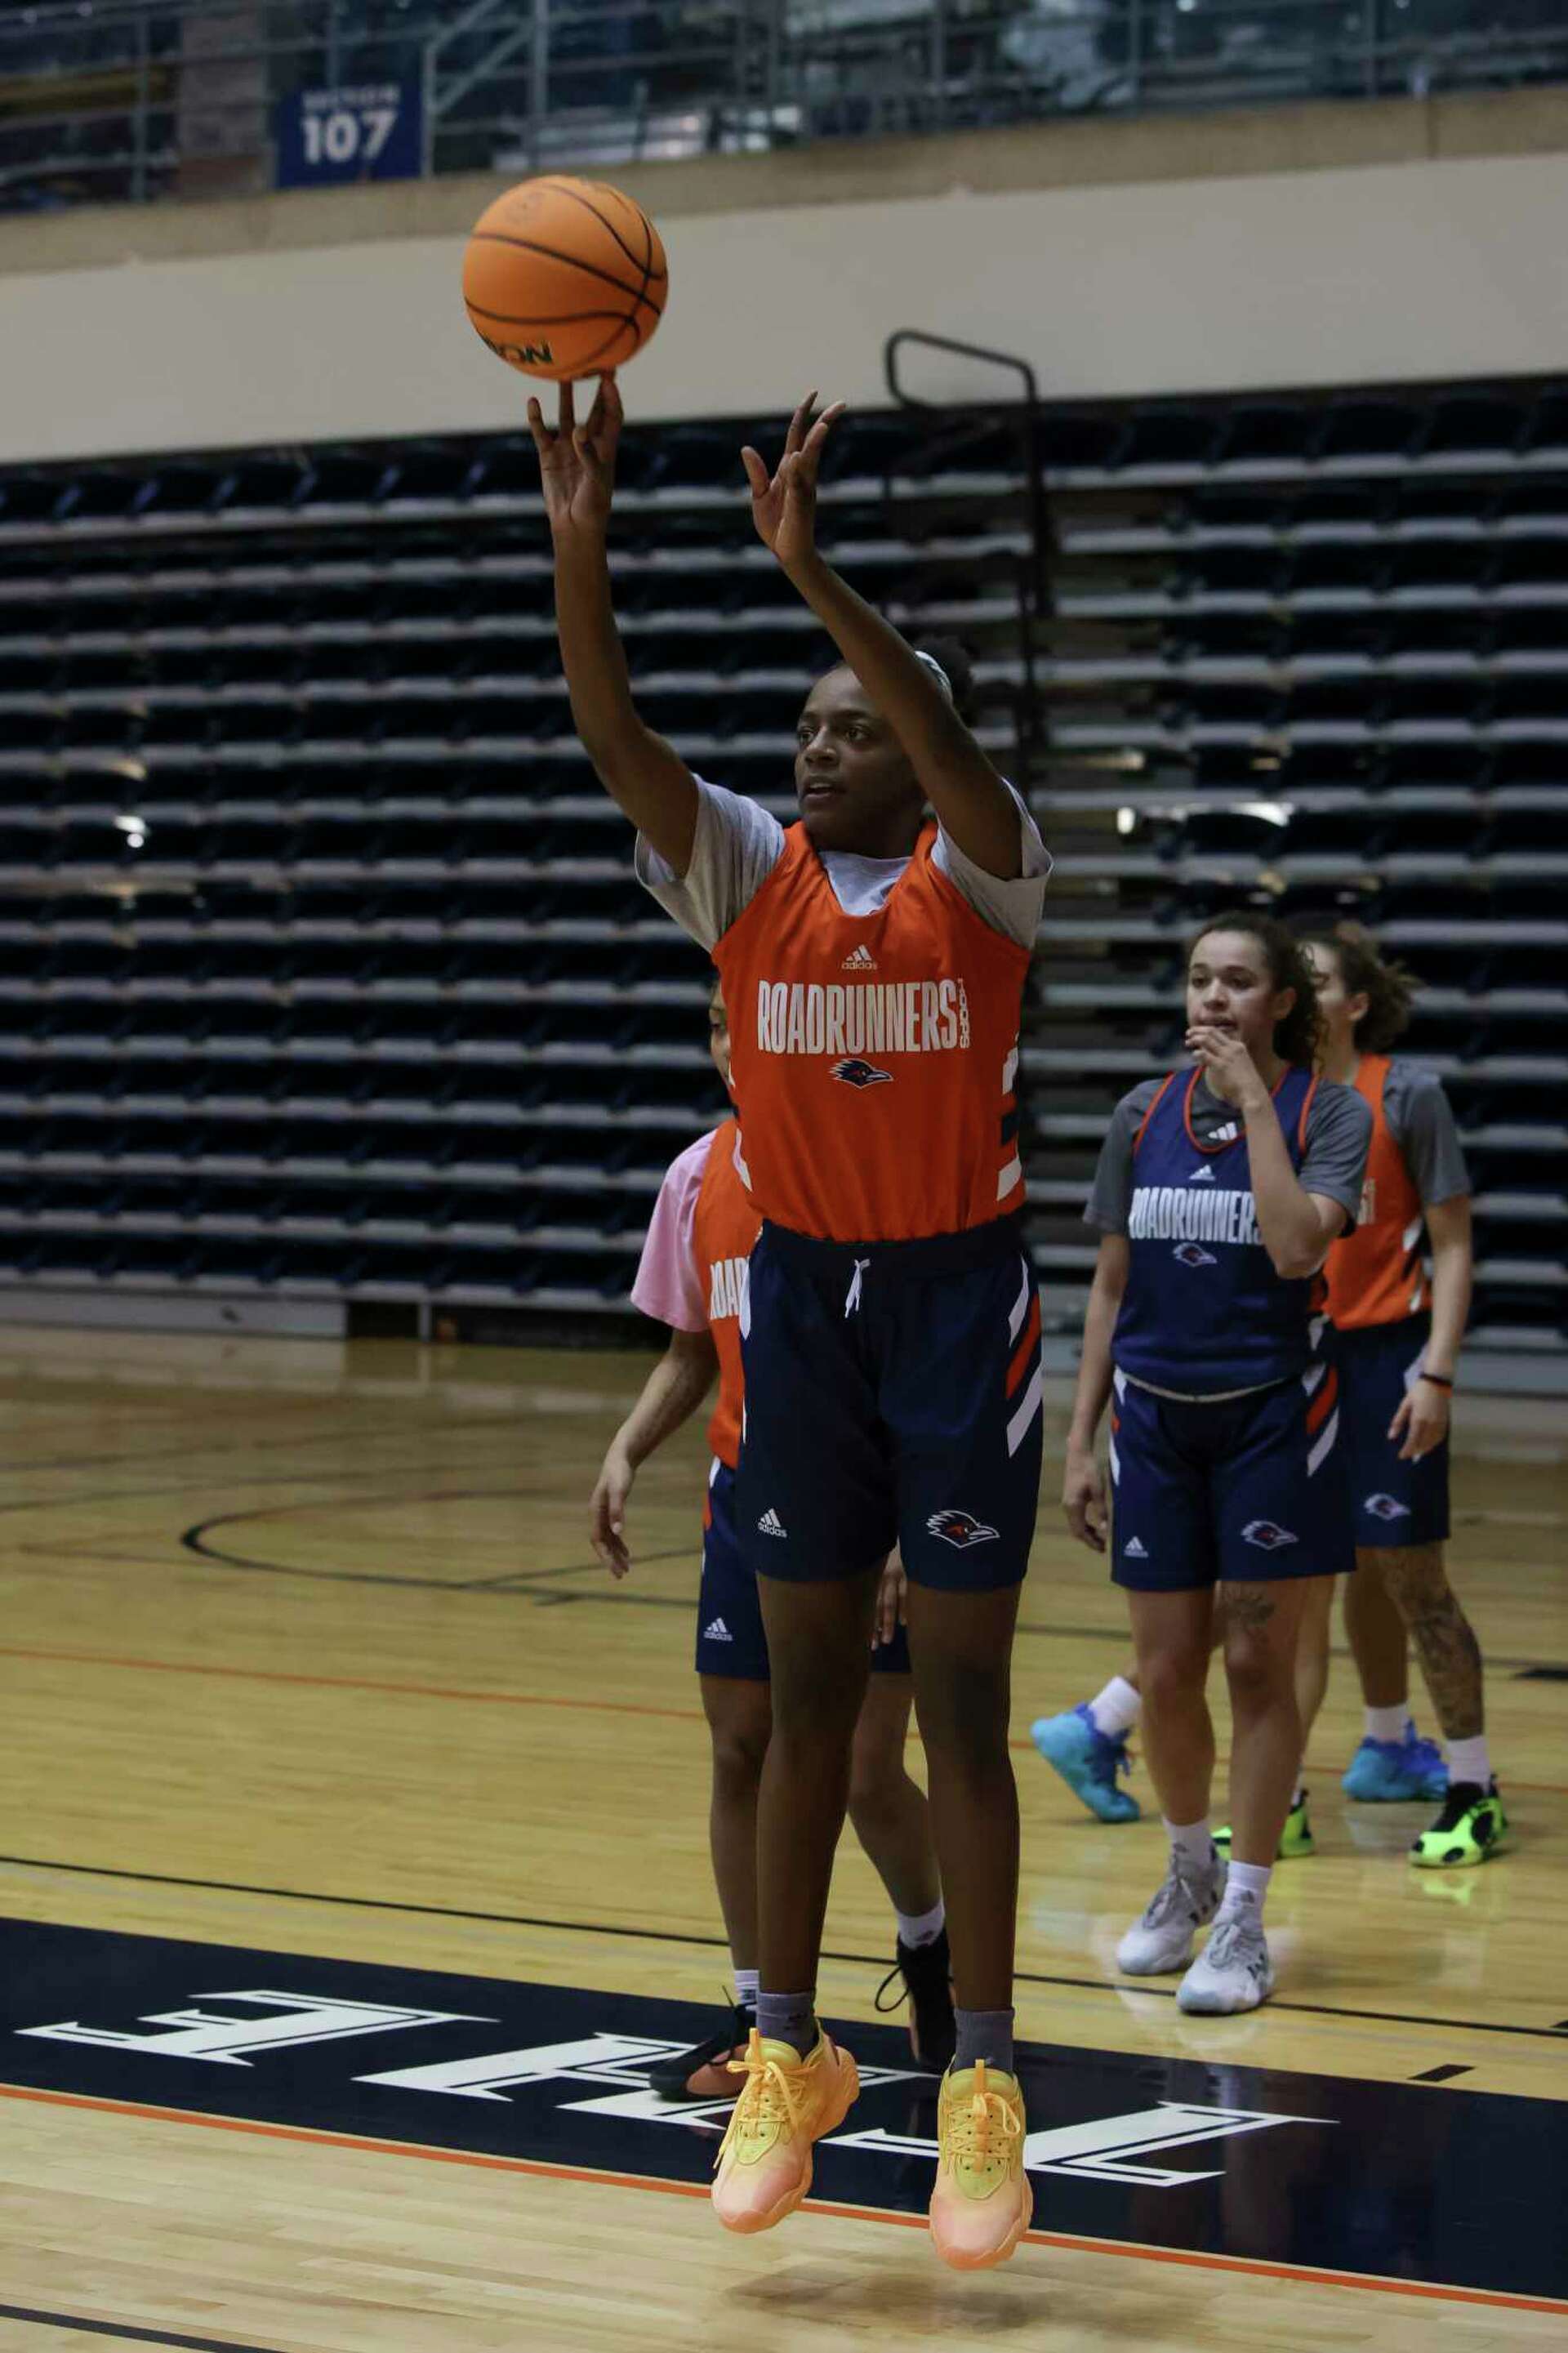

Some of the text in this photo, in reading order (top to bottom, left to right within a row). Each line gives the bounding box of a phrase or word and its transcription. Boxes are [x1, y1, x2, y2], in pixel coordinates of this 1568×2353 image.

[303, 110, 398, 163] 107
[841, 960, 878, 970] adidas
[758, 978, 957, 1055] ROADRUNNERS
[1129, 1188, 1260, 1244] ROADRUNNER
[758, 1522, 787, 1538] adidas
